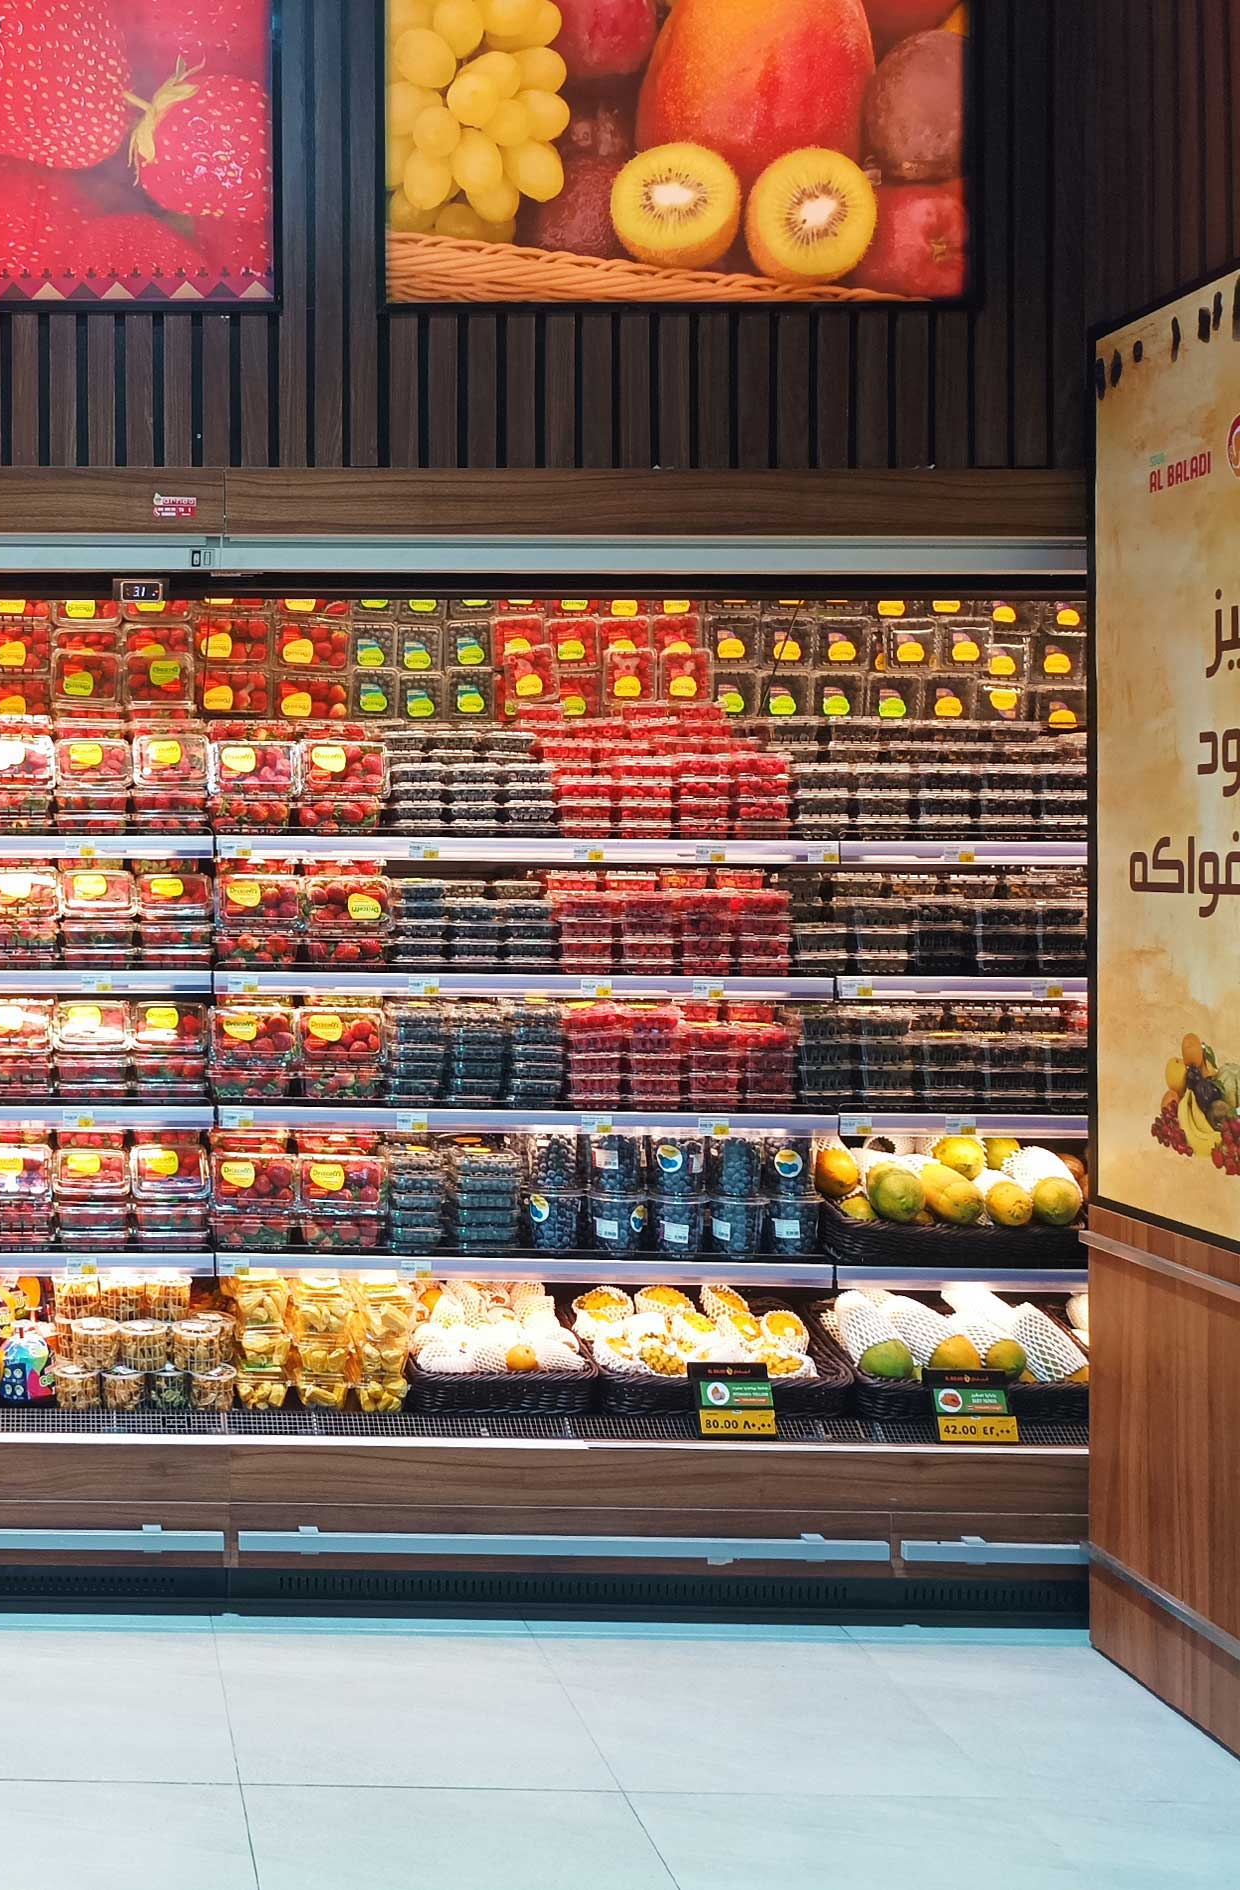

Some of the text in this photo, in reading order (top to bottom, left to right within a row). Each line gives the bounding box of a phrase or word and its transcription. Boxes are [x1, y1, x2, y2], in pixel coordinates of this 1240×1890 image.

[1149, 469, 1164, 493] AL
[1167, 451, 1212, 488] BALADI
[1129, 830, 1240, 918] فواكه
[705, 1419, 739, 1429] 80.00
[943, 1425, 977, 1435] 42.00
